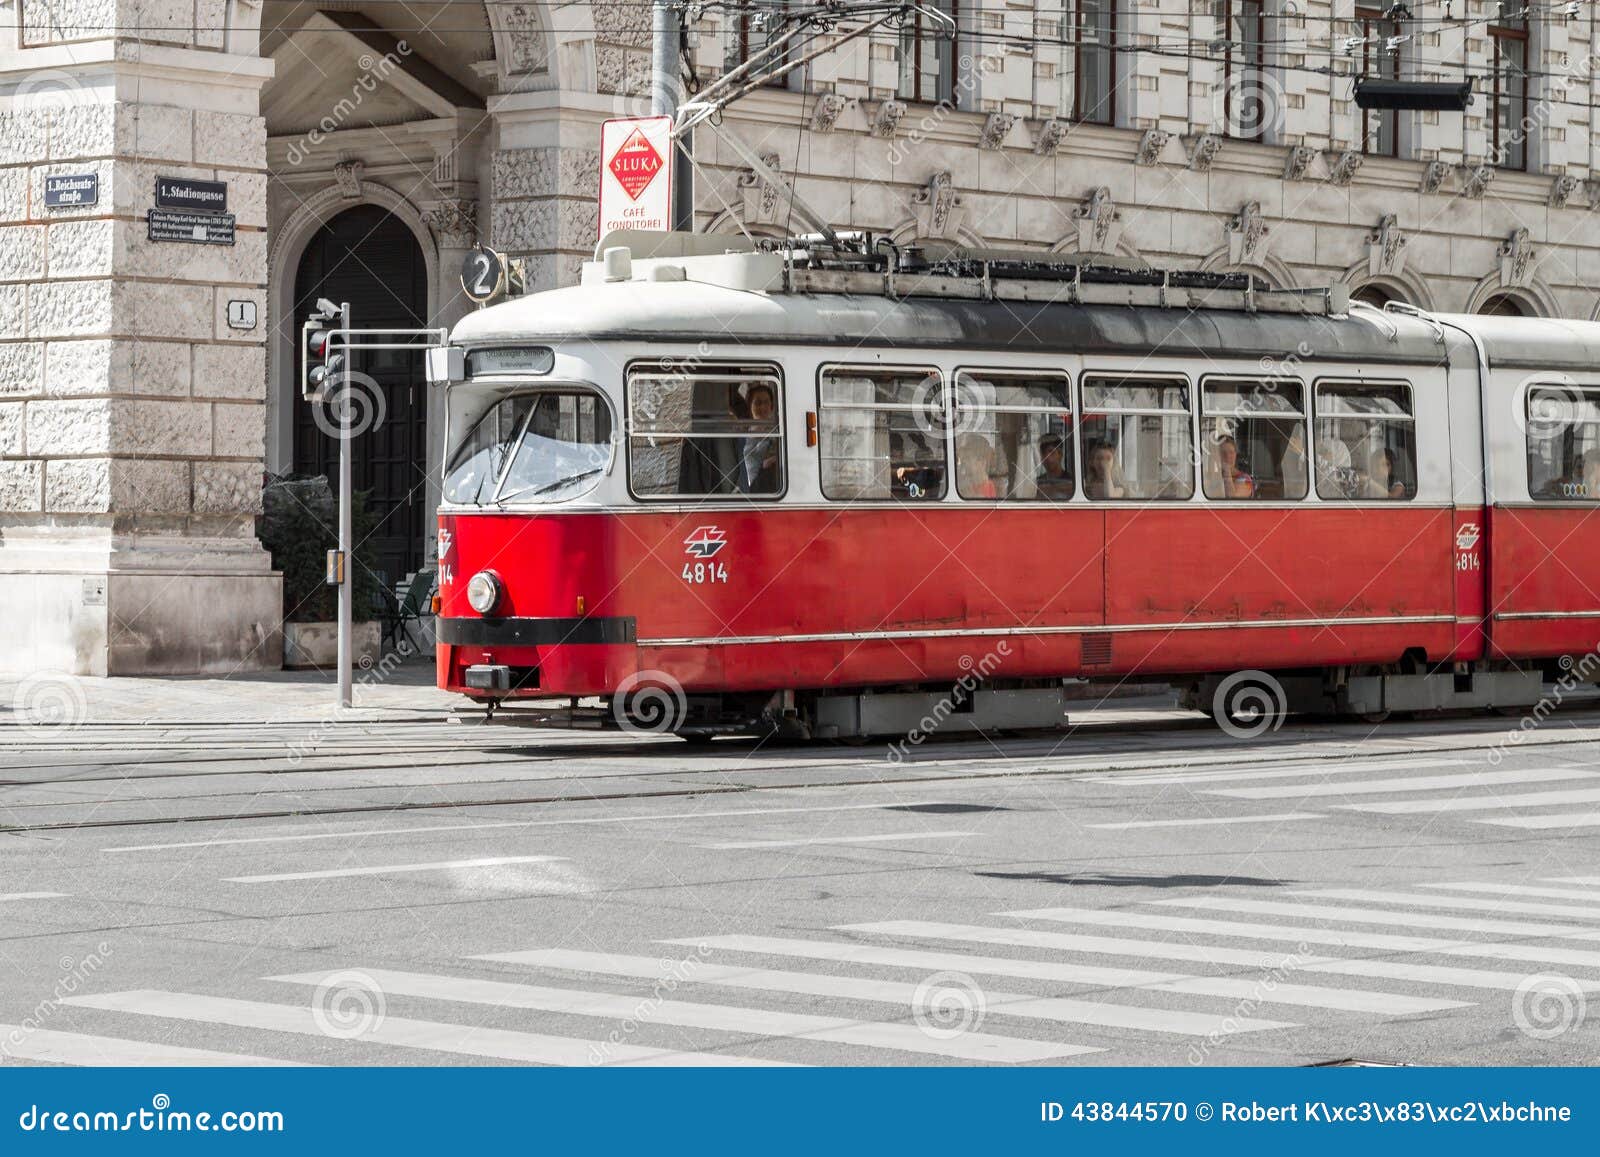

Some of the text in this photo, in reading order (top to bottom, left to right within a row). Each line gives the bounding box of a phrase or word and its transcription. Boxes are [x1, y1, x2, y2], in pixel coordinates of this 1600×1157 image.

[615, 157, 659, 172] SLUKA
[623, 205, 646, 217] CAFÉ
[607, 218, 661, 230] CONDITOREI
[473, 254, 491, 294] 2
[237, 303, 245, 320] 1
[1455, 552, 1480, 571] 4814
[681, 562, 728, 584] 4814
